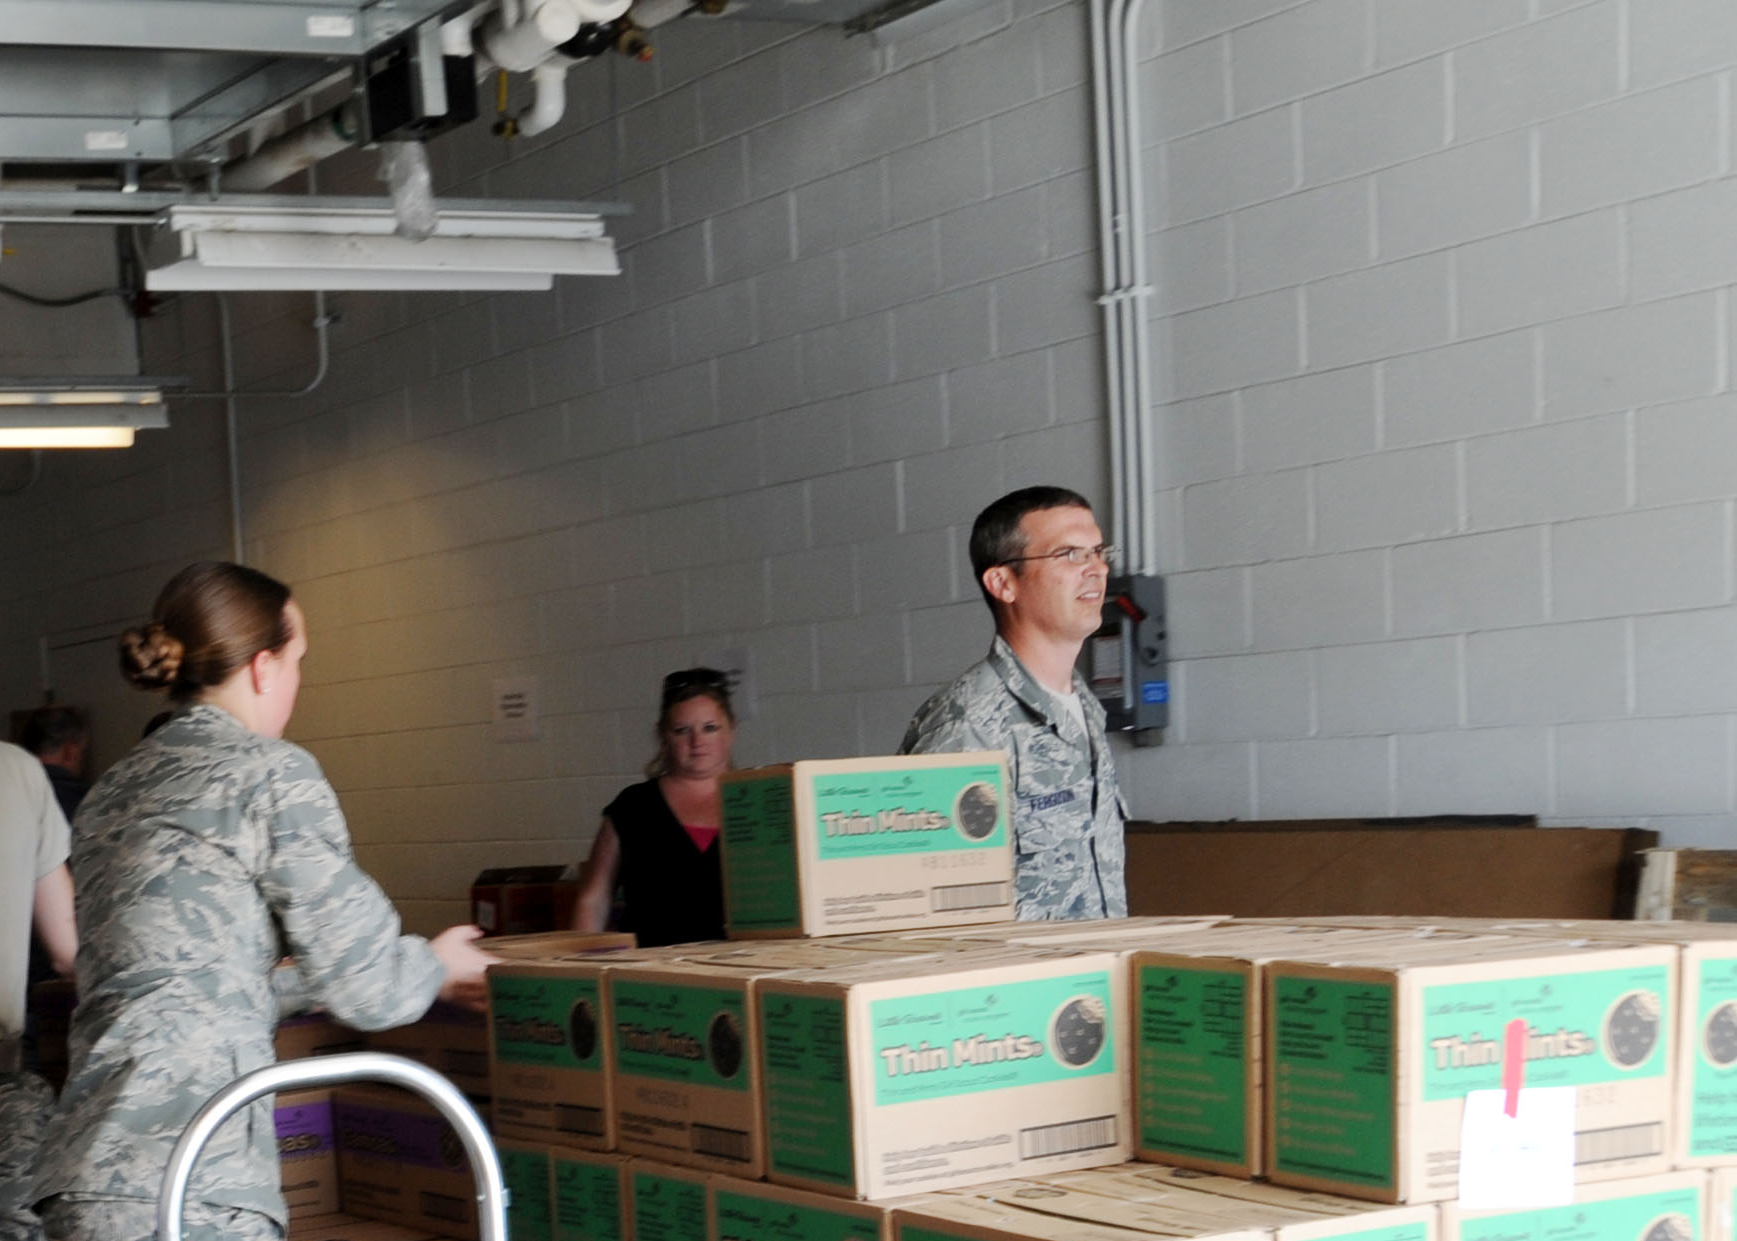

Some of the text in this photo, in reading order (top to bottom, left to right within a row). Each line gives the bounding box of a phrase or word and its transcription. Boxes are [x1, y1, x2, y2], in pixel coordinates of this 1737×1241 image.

[820, 809, 876, 838] Thin
[879, 1032, 1034, 1078] Thin Mints
[1430, 1031, 1501, 1071] Thin
